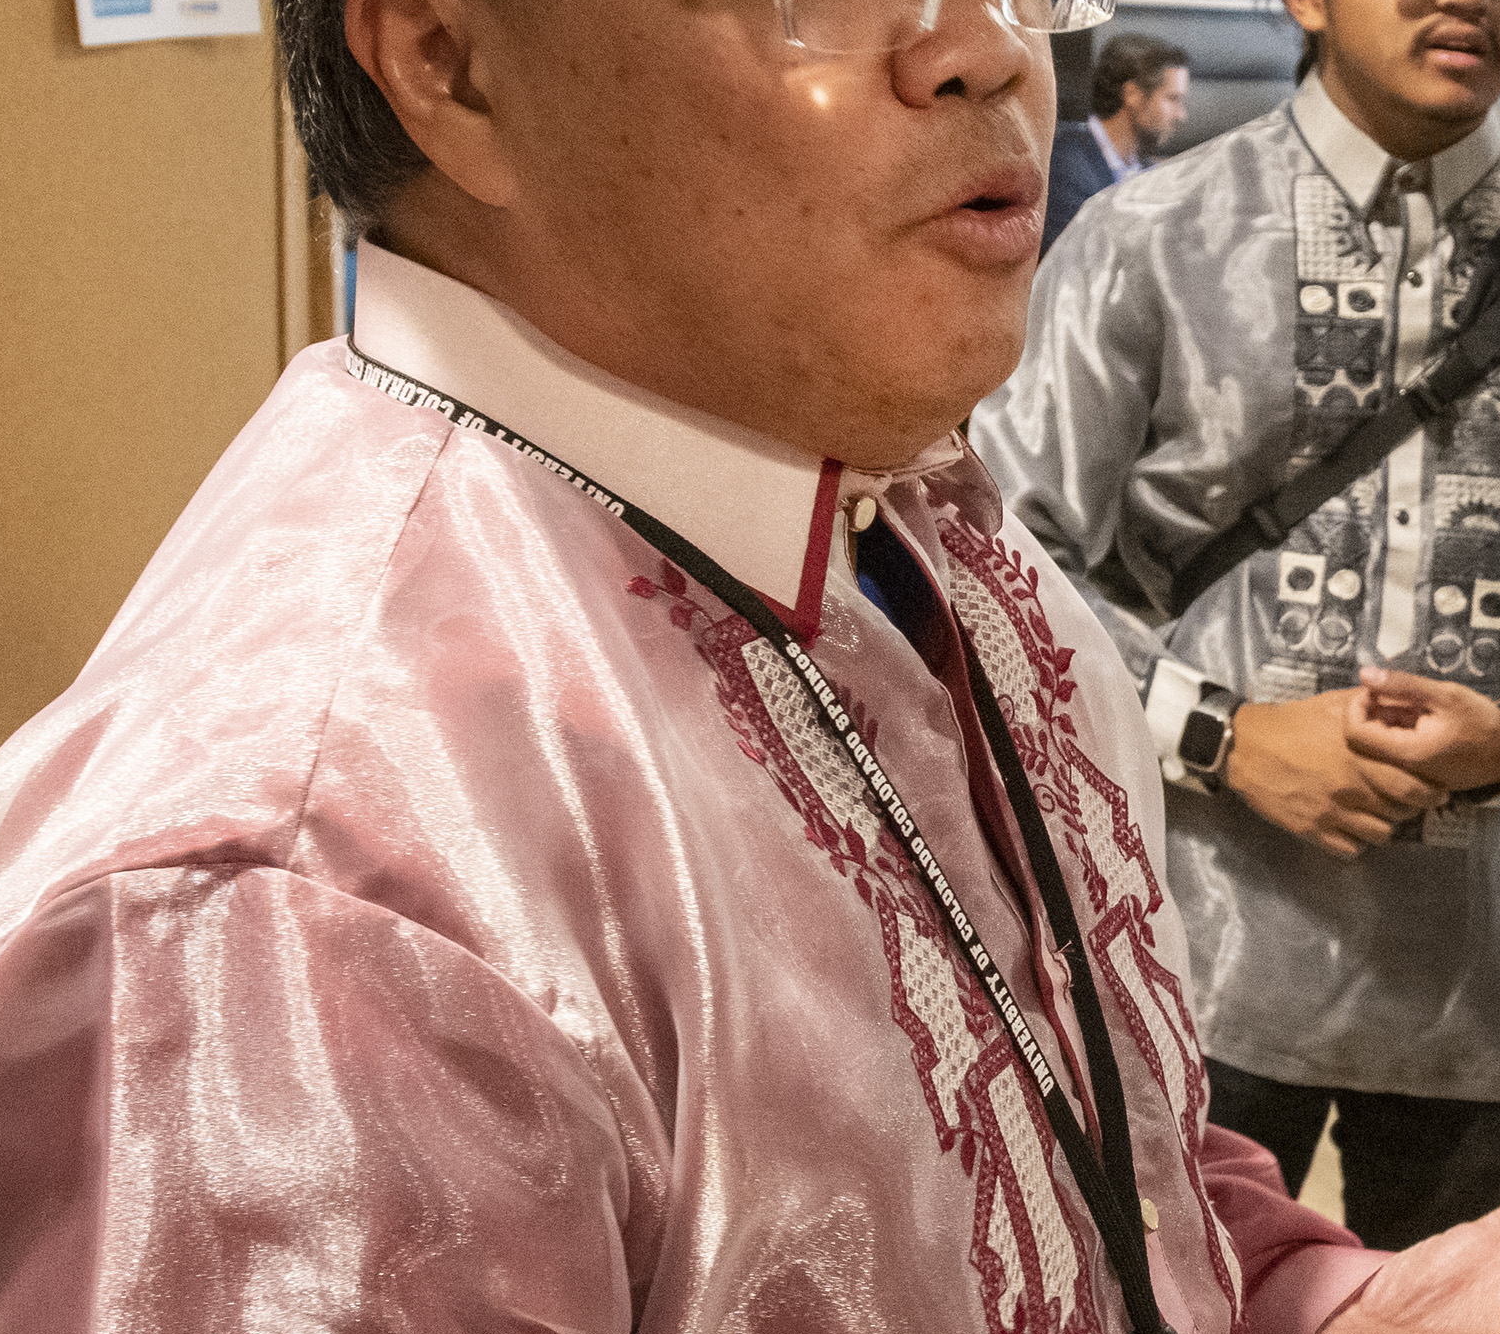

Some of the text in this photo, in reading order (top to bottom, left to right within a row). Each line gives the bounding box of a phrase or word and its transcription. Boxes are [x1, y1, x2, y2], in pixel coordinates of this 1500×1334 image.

[845, 727, 915, 838] COLORADO
[911, 834, 972, 945] COLORADO
[969, 941, 993, 970] OF
[986, 967, 1054, 1097] UNIVERSITY
